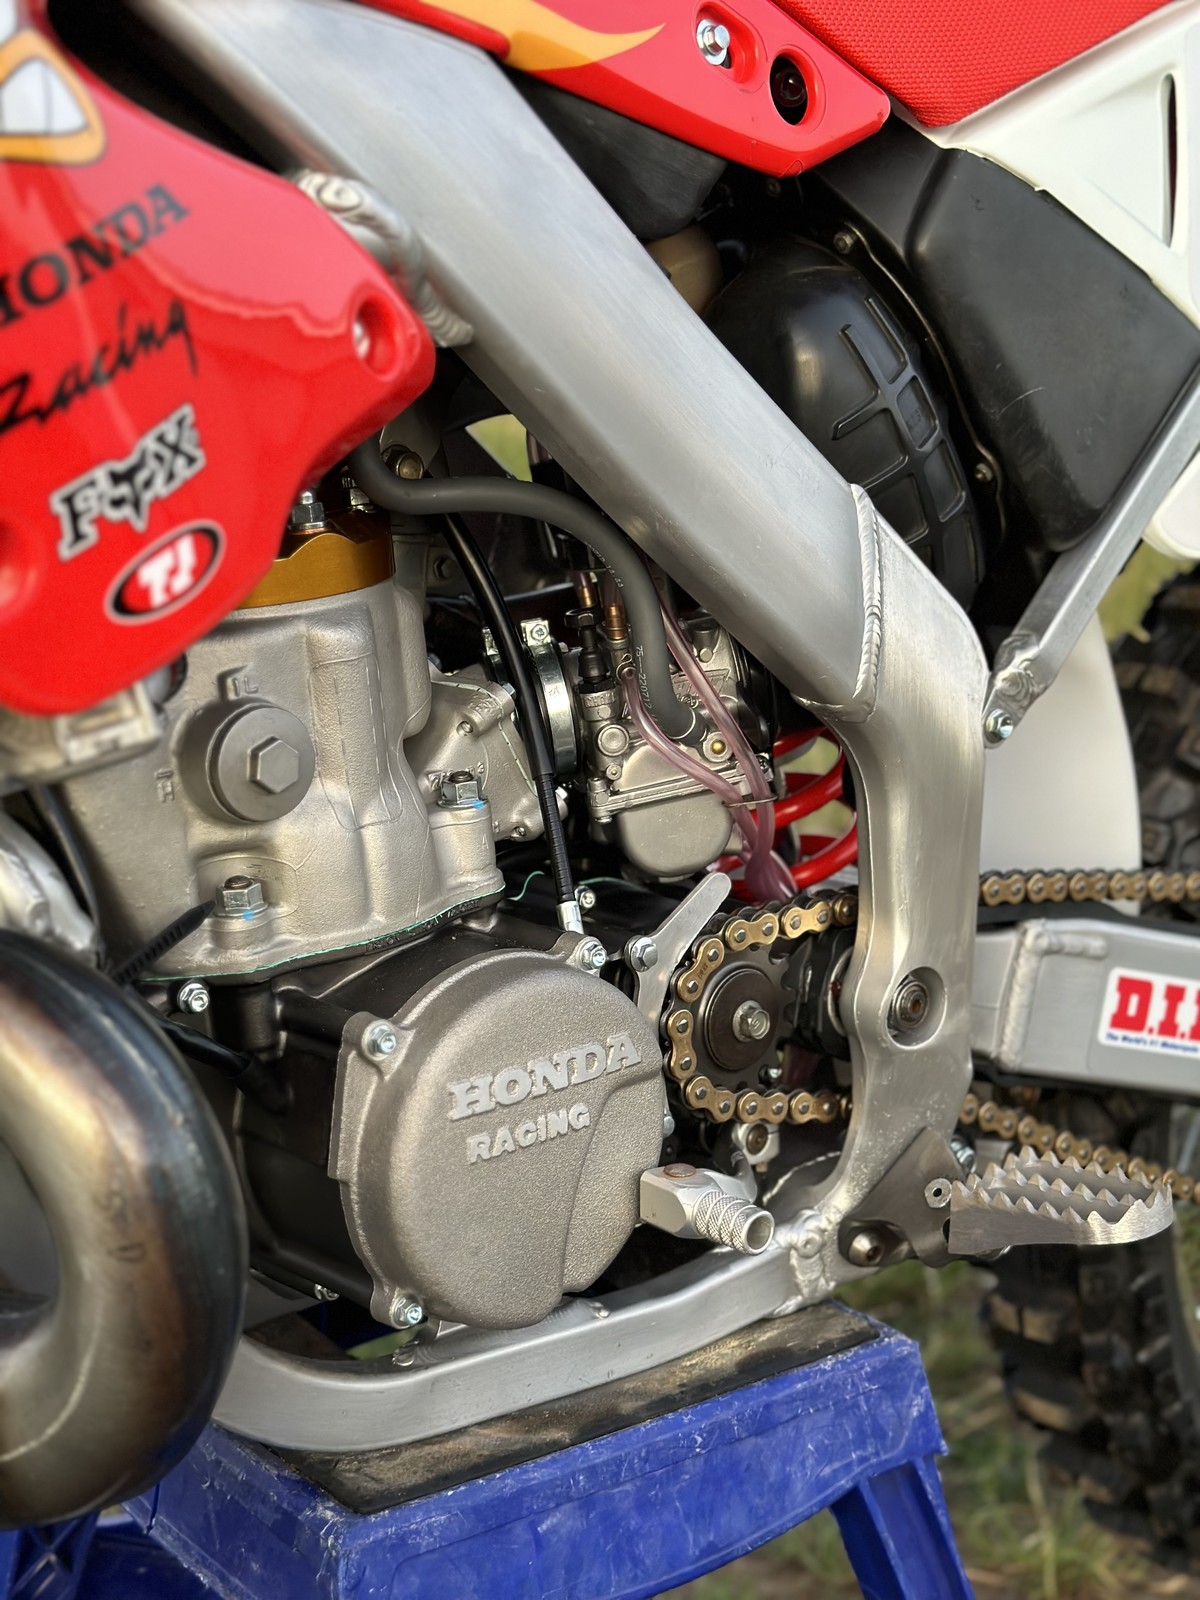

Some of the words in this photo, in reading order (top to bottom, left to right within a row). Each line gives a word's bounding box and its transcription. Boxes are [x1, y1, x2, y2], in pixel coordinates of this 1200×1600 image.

[1109, 975, 1200, 1042] D.I.
[448, 1032, 642, 1121] HONDA
[467, 1102, 591, 1165] RACING
